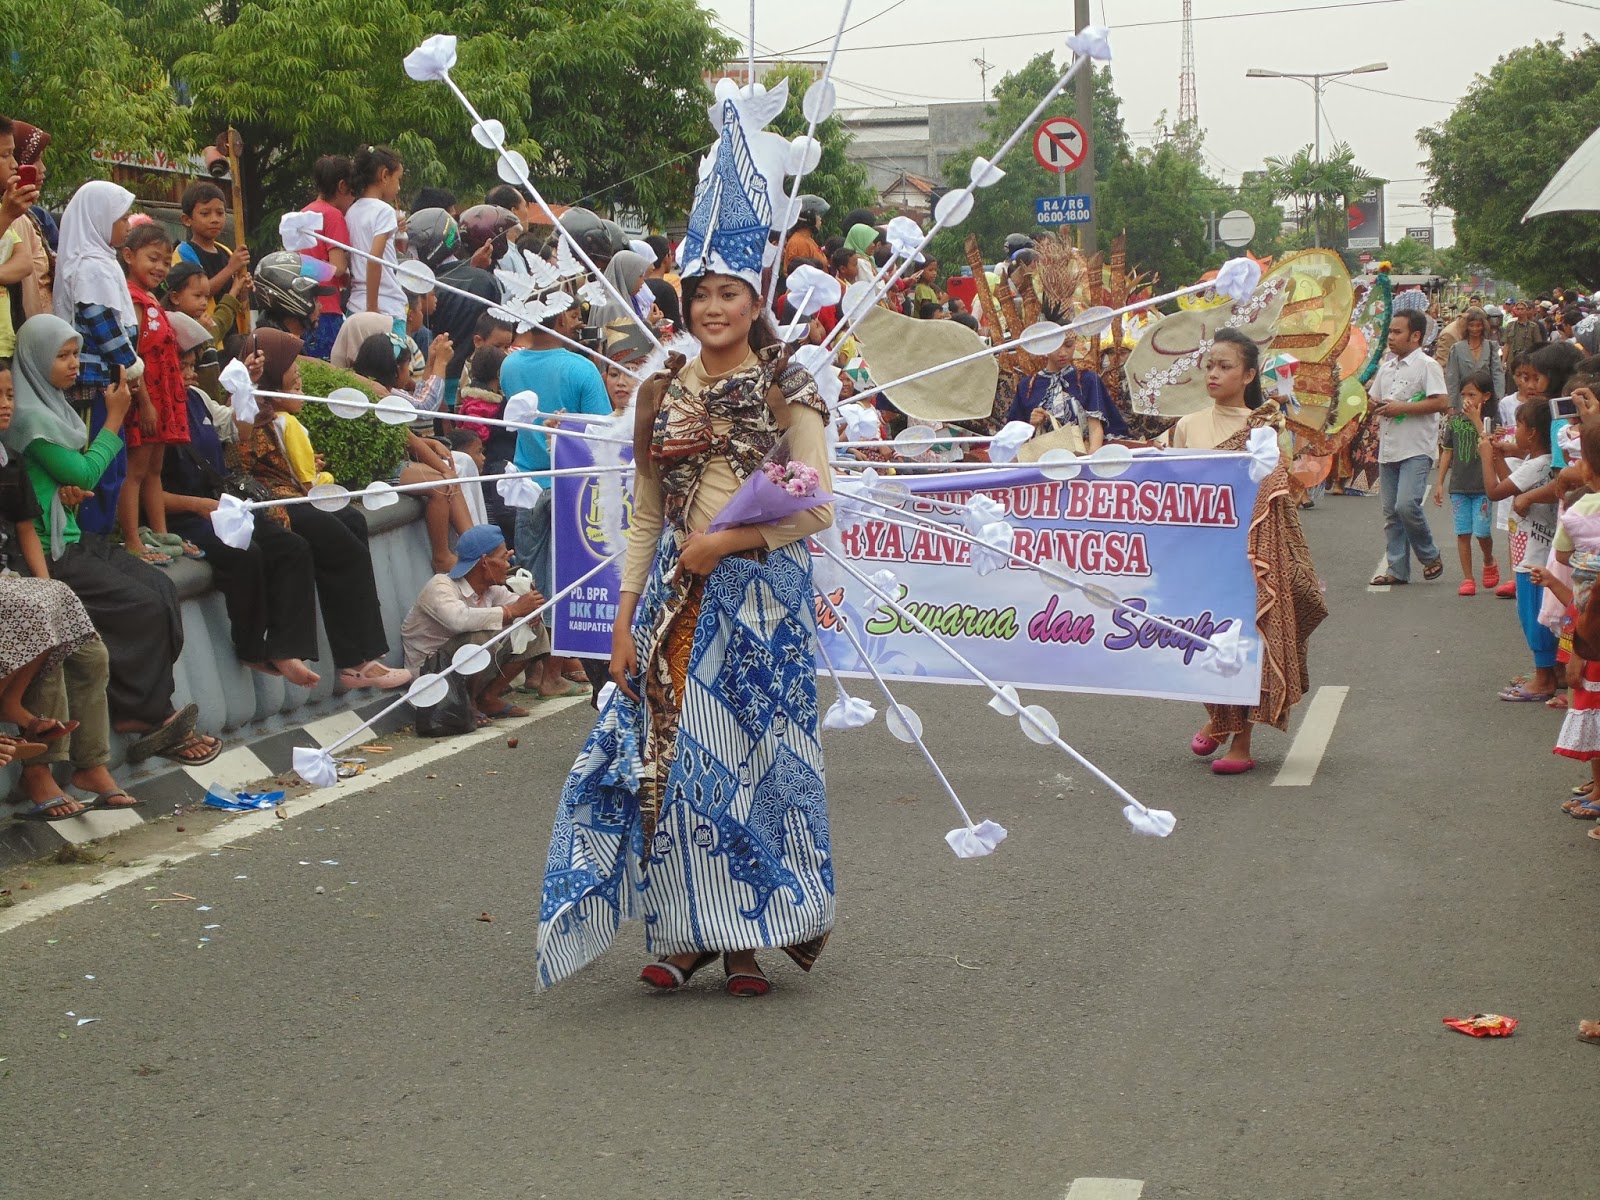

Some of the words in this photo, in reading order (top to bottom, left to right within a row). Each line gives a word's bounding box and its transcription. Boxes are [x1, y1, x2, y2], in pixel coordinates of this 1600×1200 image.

[1066, 481, 1237, 526] BERSAMA
[1530, 530, 1551, 547] KITT
[808, 520, 905, 562] RYA
[911, 522, 976, 565] ANA
[1009, 529, 1150, 576] BANGSA
[586, 586, 608, 601] BPR
[569, 601, 592, 618] BKK
[569, 620, 614, 633] KABUPATEN
[1028, 594, 1095, 645] dan
